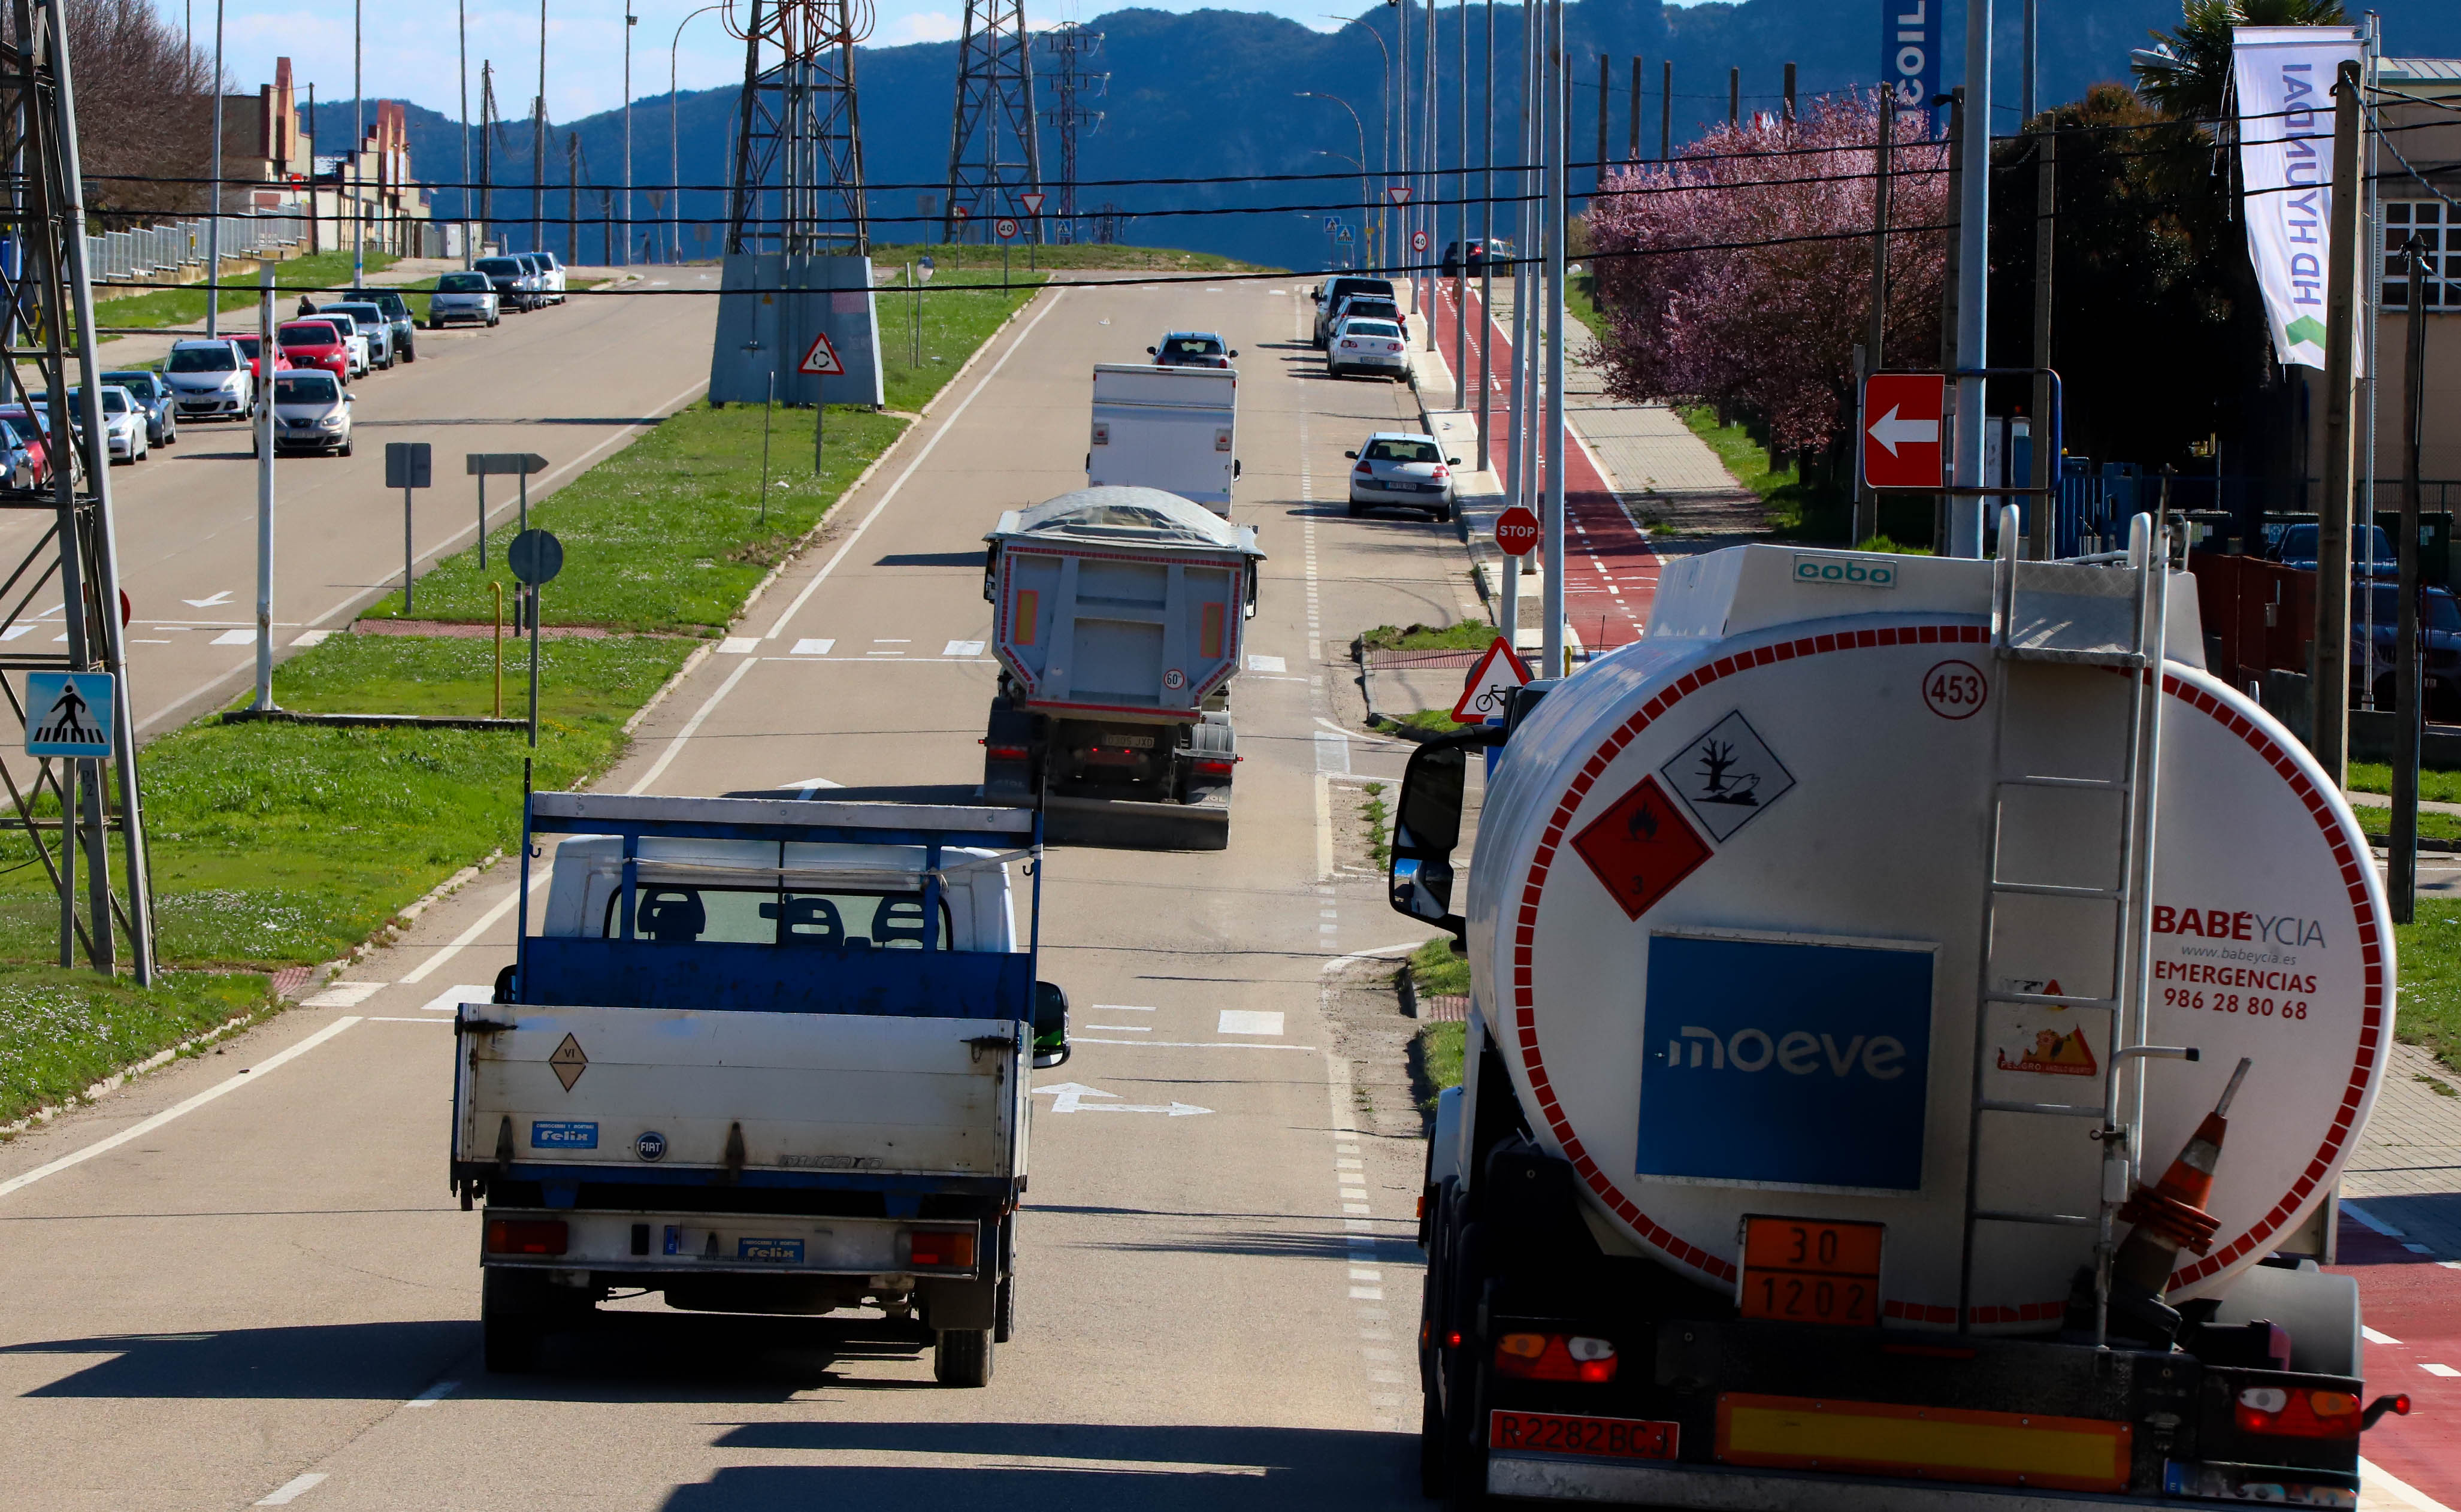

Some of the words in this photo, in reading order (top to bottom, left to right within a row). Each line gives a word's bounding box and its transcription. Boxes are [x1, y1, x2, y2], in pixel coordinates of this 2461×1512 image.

[1499, 525, 1535, 537] STOP
[1798, 561, 1891, 583] cobo
[1167, 673, 1178, 685] 60
[1931, 675, 1978, 704] 453
[1631, 875, 1644, 895] 3
[2181, 945, 2296, 965] www.babeycia.es
[2155, 960, 2317, 994] EMERGENCIAS
[2164, 987, 2204, 1009] 986
[2212, 993, 2239, 1013] 28
[2247, 996, 2274, 1017] 80
[2281, 1000, 2307, 1020] 68
[564, 1048, 575, 1058] VI
[1668, 1025, 1906, 1080] moeve
[640, 1142, 661, 1152] FIAT
[1788, 1227, 1838, 1265] 30
[1761, 1277, 1864, 1320] 1202
